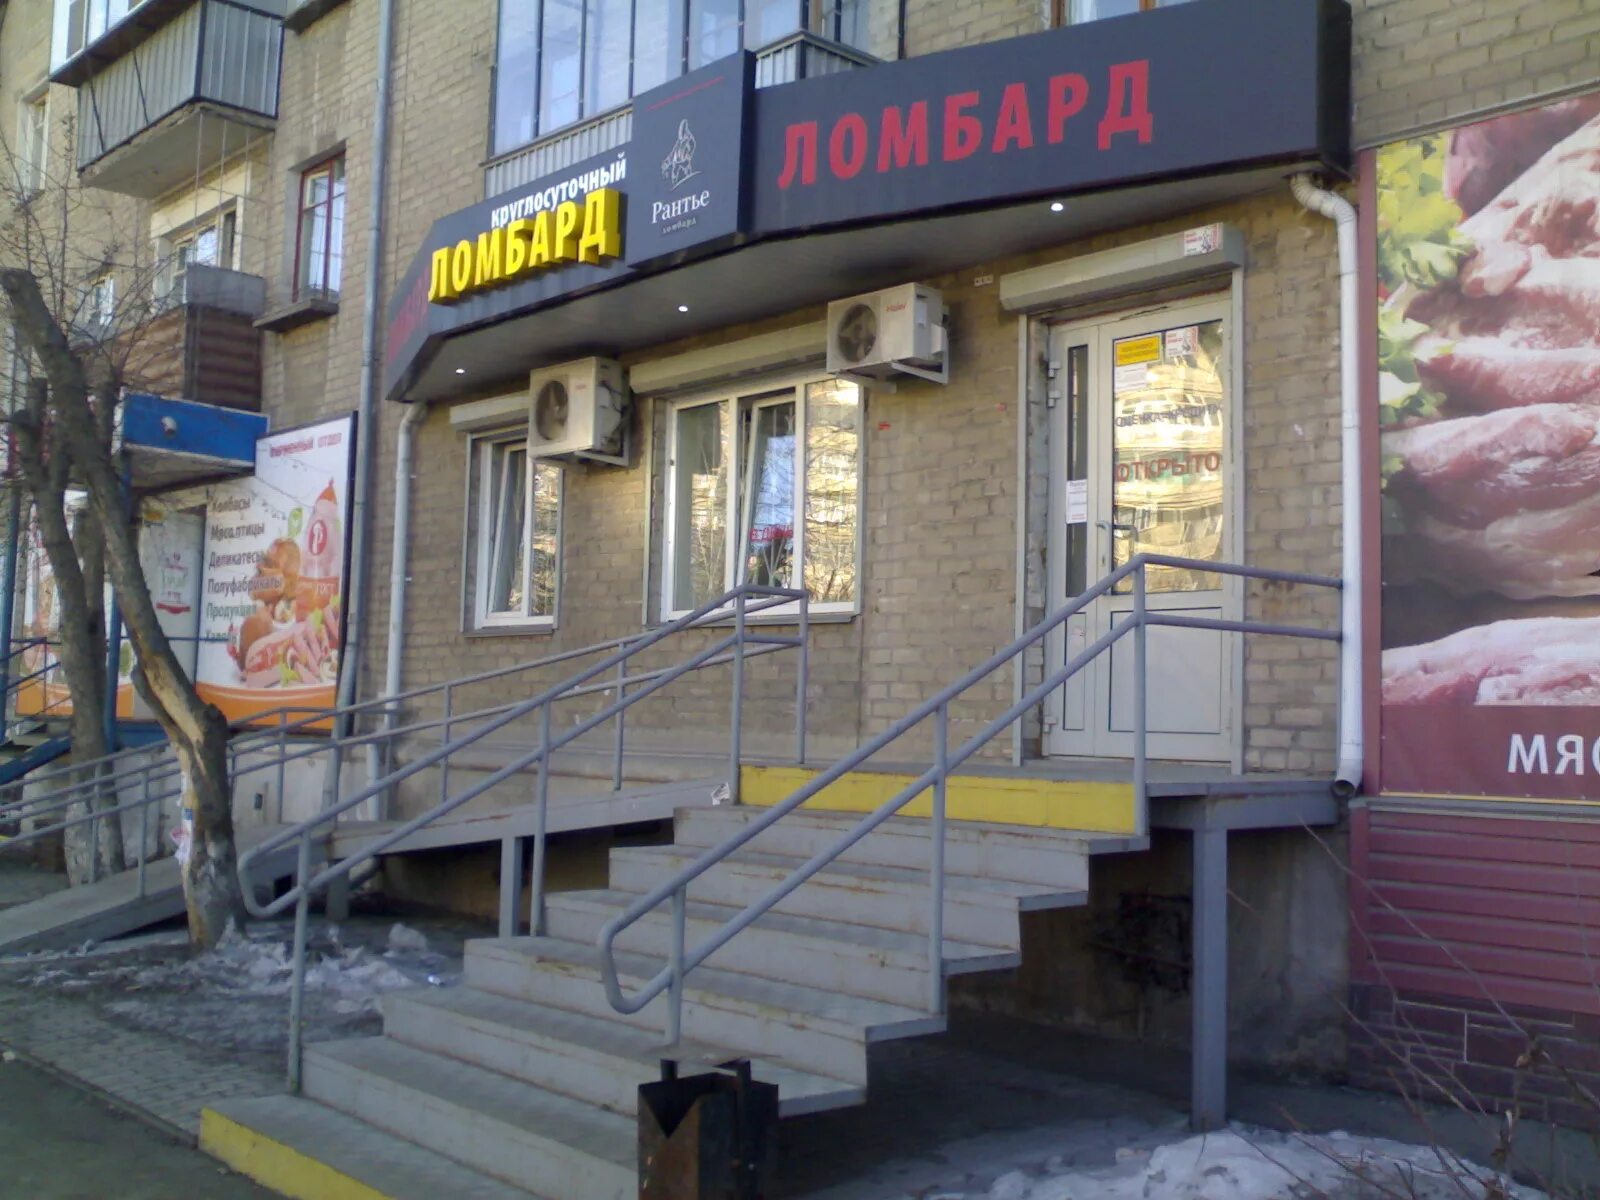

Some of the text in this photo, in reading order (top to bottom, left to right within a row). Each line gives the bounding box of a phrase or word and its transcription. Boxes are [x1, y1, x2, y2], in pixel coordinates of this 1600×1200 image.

[777, 60, 1153, 190] ЛОМБАРД
[651, 190, 710, 224] Рантье
[428, 188, 620, 304] ЛОМБАРД
[1116, 452, 1220, 482] ОТКРЫТО
[207, 576, 282, 597] Полуфабрикаты
[1507, 734, 1600, 776] МЯ
